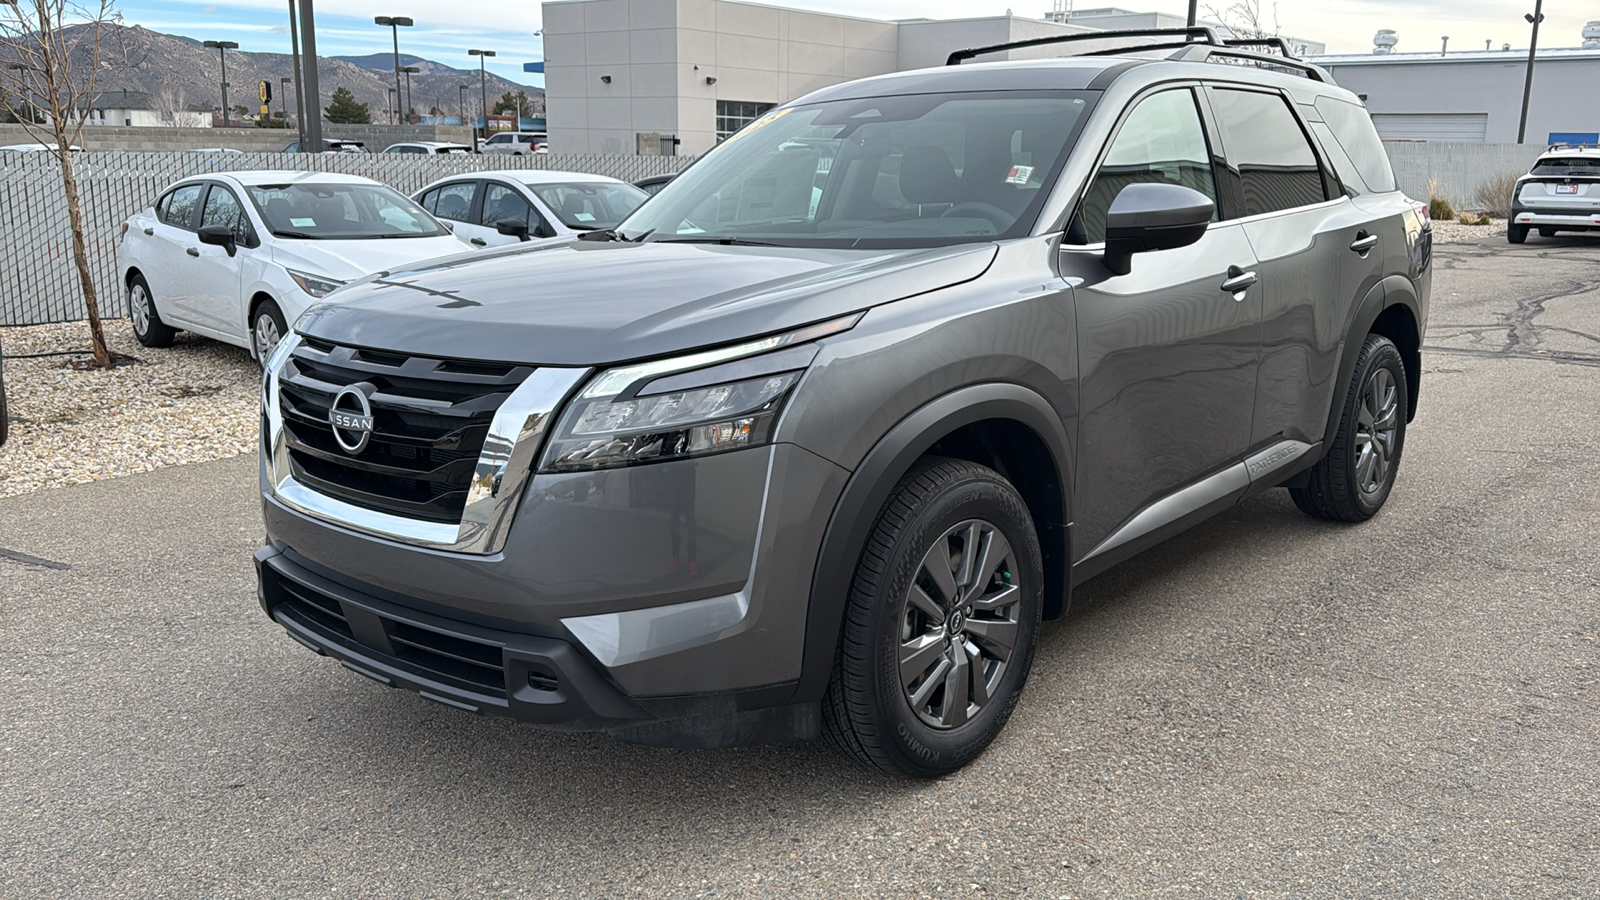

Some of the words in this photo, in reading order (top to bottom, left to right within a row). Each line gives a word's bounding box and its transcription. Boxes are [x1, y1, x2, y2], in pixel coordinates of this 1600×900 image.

[328, 411, 372, 430] NISSAN
[1249, 442, 1300, 475] PATHFINDER
[897, 721, 940, 762] KUMHO
